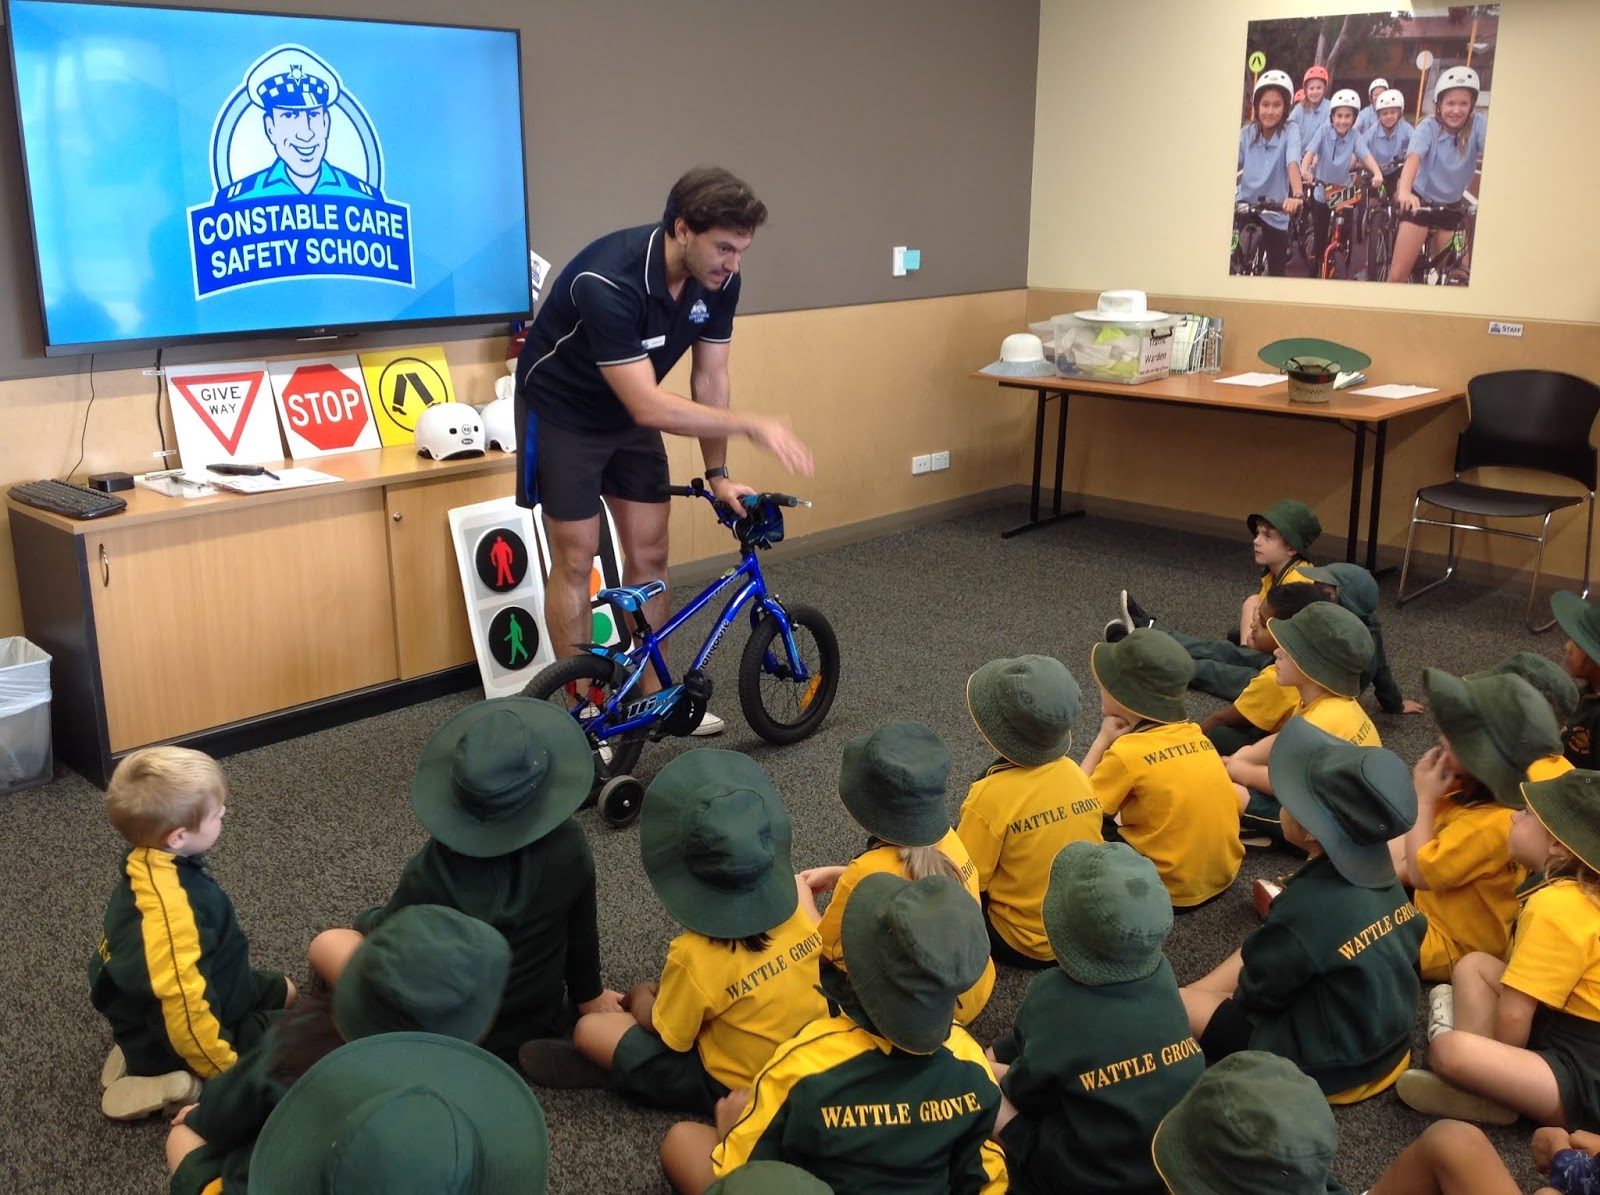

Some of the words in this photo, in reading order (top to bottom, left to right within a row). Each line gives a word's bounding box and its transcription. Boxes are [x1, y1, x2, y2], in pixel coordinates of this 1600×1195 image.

[199, 204, 339, 245] CONSTABLE
[345, 206, 404, 239] CARE
[211, 239, 299, 278] SAFETY
[305, 238, 399, 271] SCHOOL
[1502, 324, 1521, 333] STAFF
[1145, 351, 1167, 364] Warden
[200, 386, 241, 401] GIVE
[209, 403, 237, 415] WAY
[288, 388, 360, 427] STOP
[699, 620, 731, 670] ongoose
[1143, 741, 1199, 765] WATTLE
[1010, 806, 1068, 834] WATTLE
[1338, 915, 1393, 960] WATTLE
[1394, 901, 1420, 925] GRO
[725, 954, 788, 1001] WATTLE
[789, 932, 822, 962] GROVE
[1079, 1052, 1157, 1092] WATTLE
[820, 1103, 912, 1129] WATTLE
[919, 1092, 982, 1122] GROVE
